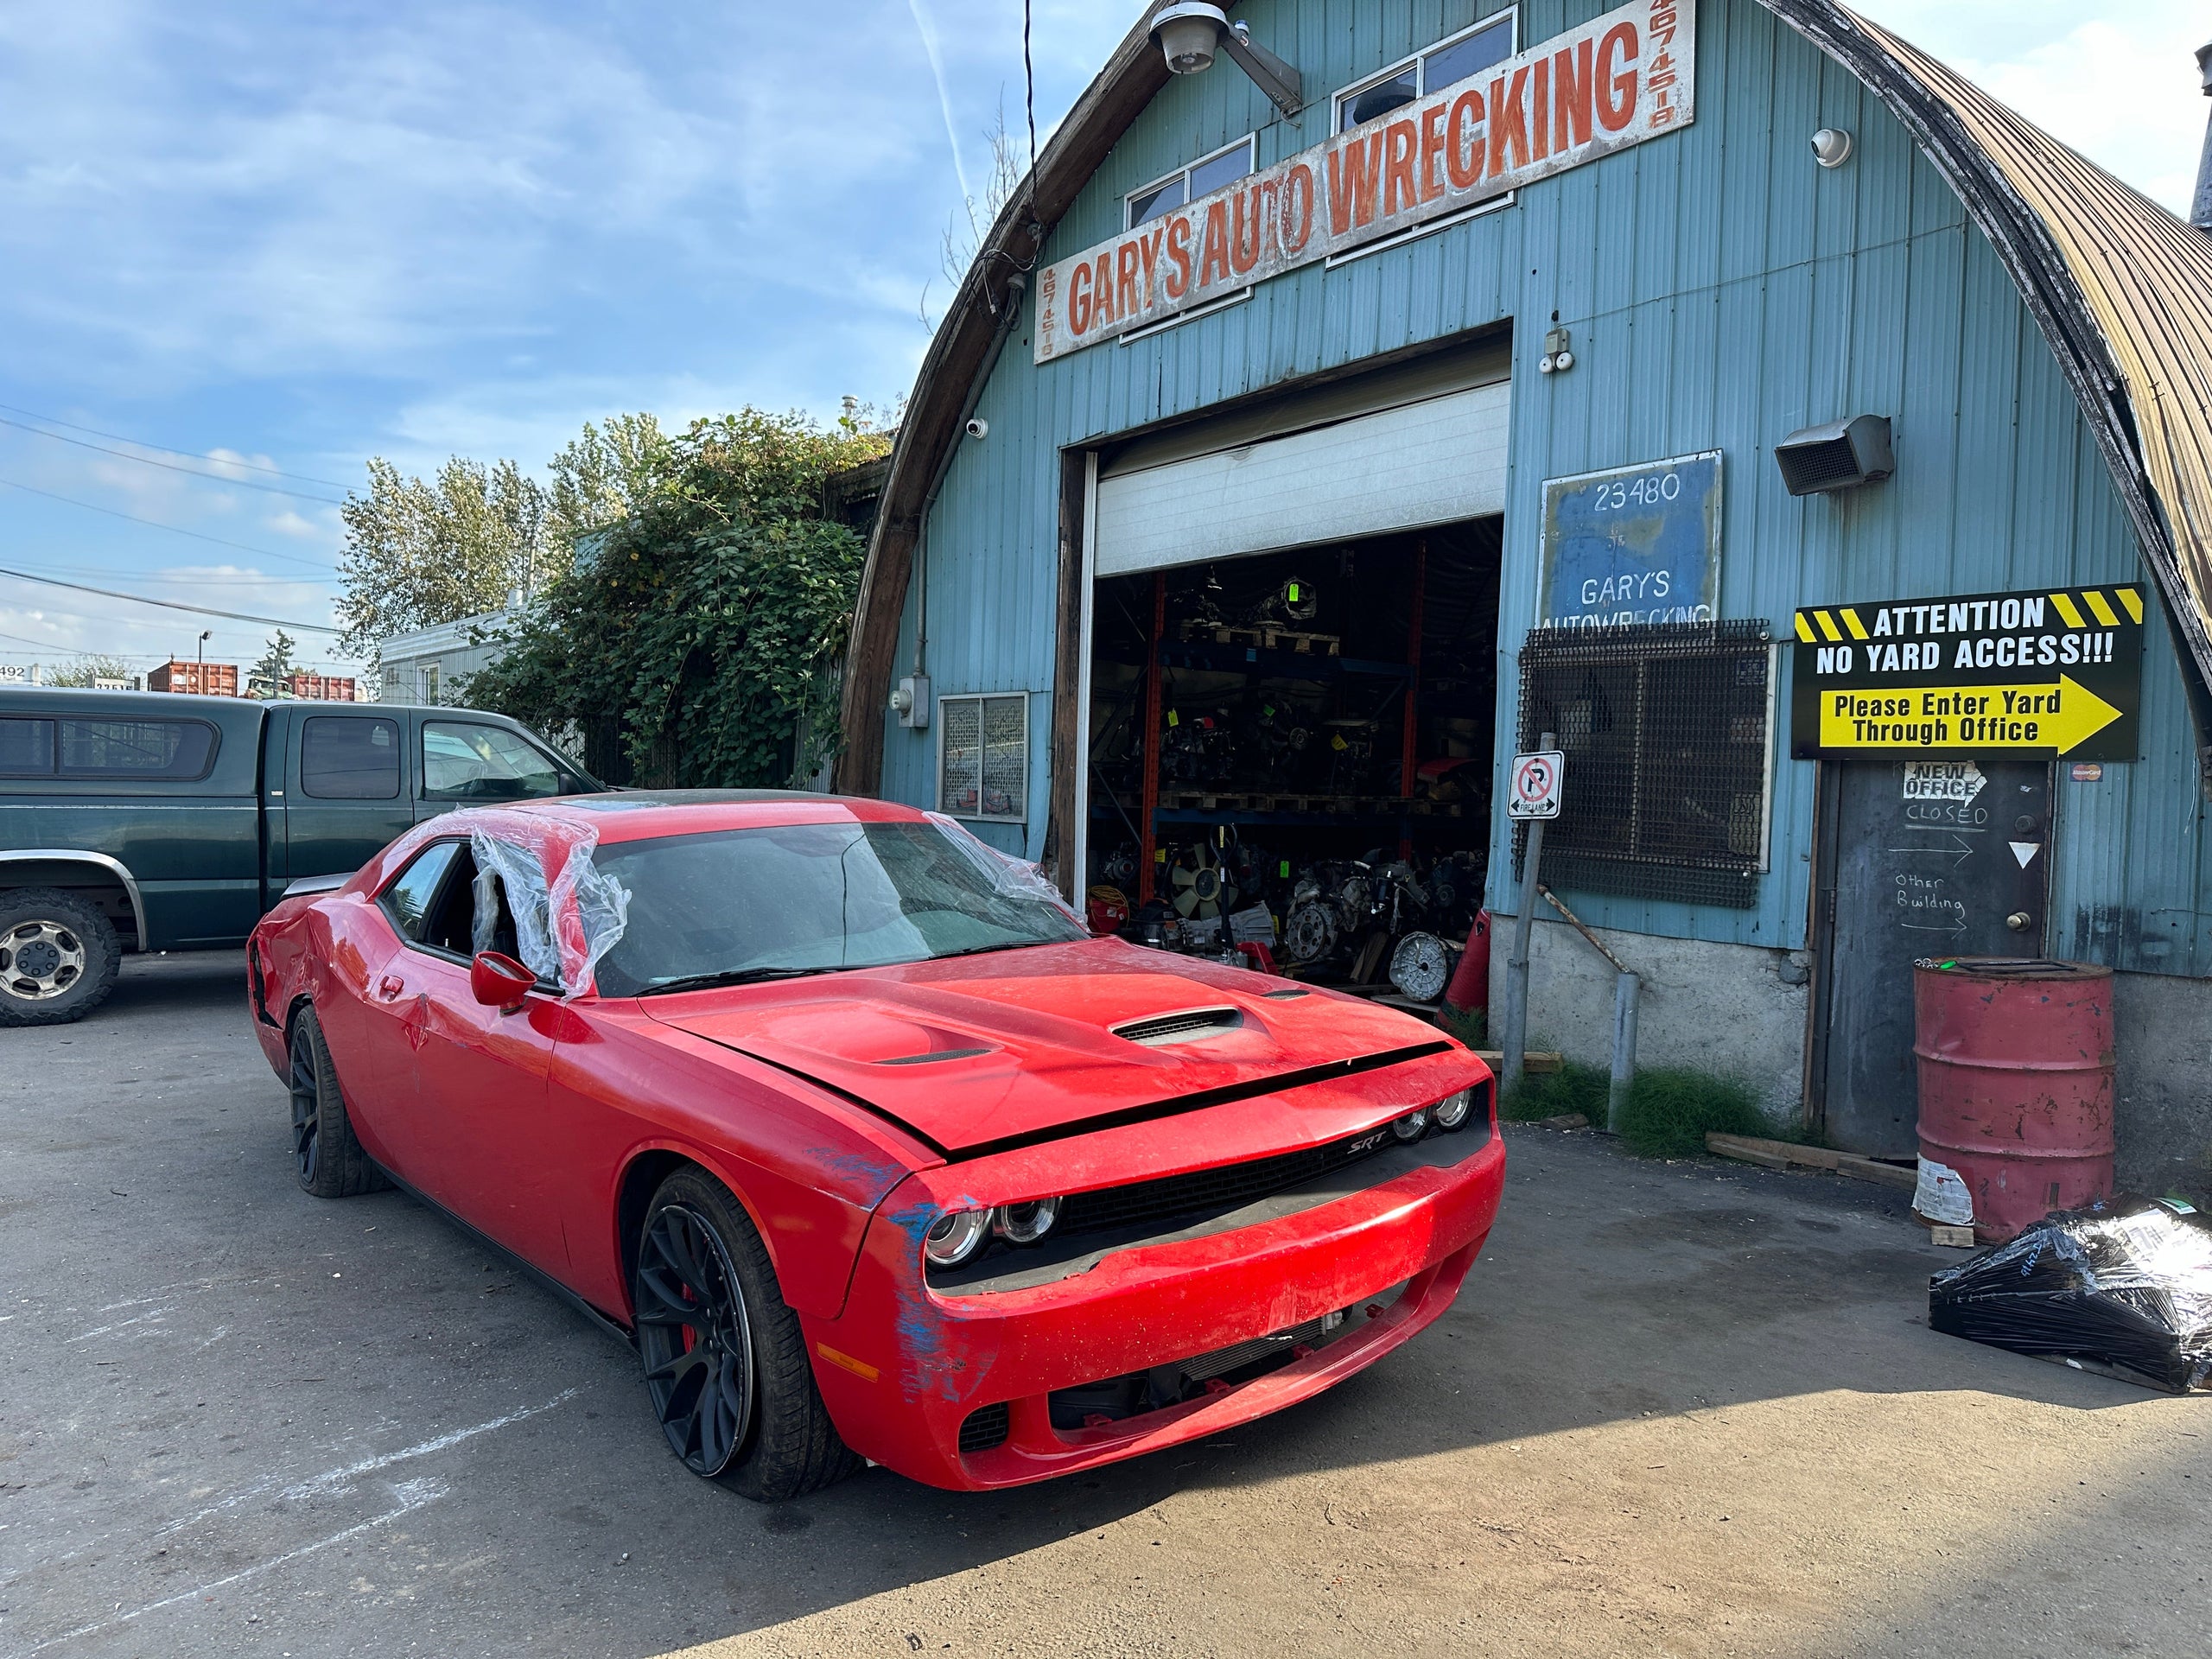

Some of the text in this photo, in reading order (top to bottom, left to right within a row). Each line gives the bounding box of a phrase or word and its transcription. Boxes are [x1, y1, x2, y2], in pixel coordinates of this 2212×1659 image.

[1069, 22, 1638, 335] GARY'S AUTO WRECKING
[1594, 473, 1681, 512] 23480
[1581, 570, 1670, 605] GARY'S
[1872, 597, 2044, 637] ATTENTION
[1816, 632, 2113, 674] NO YARD ACCESS!!!
[1835, 690, 2061, 717] Please Enter Yard
[1853, 718, 2038, 746] Through Office
[1916, 764, 1967, 779] NEW
[1906, 779, 1977, 796] OFFICE
[1520, 804, 1531, 812] FIRE
[1907, 804, 1987, 824] CLOSED
[1897, 890, 1966, 920] Building
[1347, 1130, 1387, 1154] SRT
